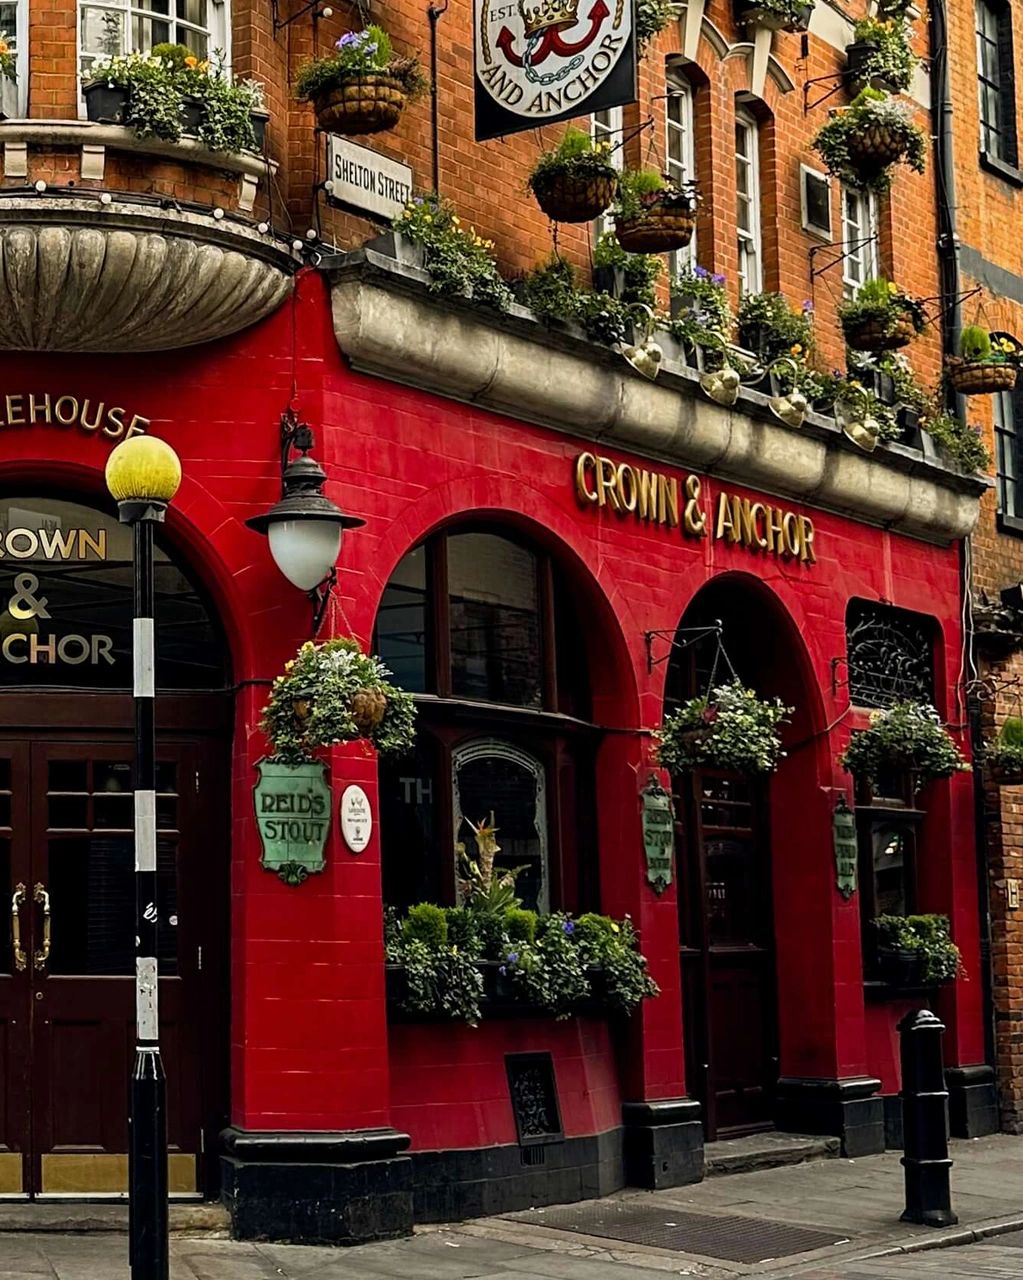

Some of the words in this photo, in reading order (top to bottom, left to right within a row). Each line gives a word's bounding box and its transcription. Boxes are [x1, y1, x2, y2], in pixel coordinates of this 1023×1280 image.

[480, 63, 524, 106] AND
[527, 33, 623, 114] ANCHOR
[336, 154, 376, 193] SHELTON
[378, 171, 410, 207] STREET
[577, 452, 678, 526] CROWN
[684, 474, 707, 537] &
[716, 492, 816, 563] ANCHOR
[8, 572, 52, 620] &
[261, 787, 326, 814] REID'S
[265, 821, 324, 842] STOUT
